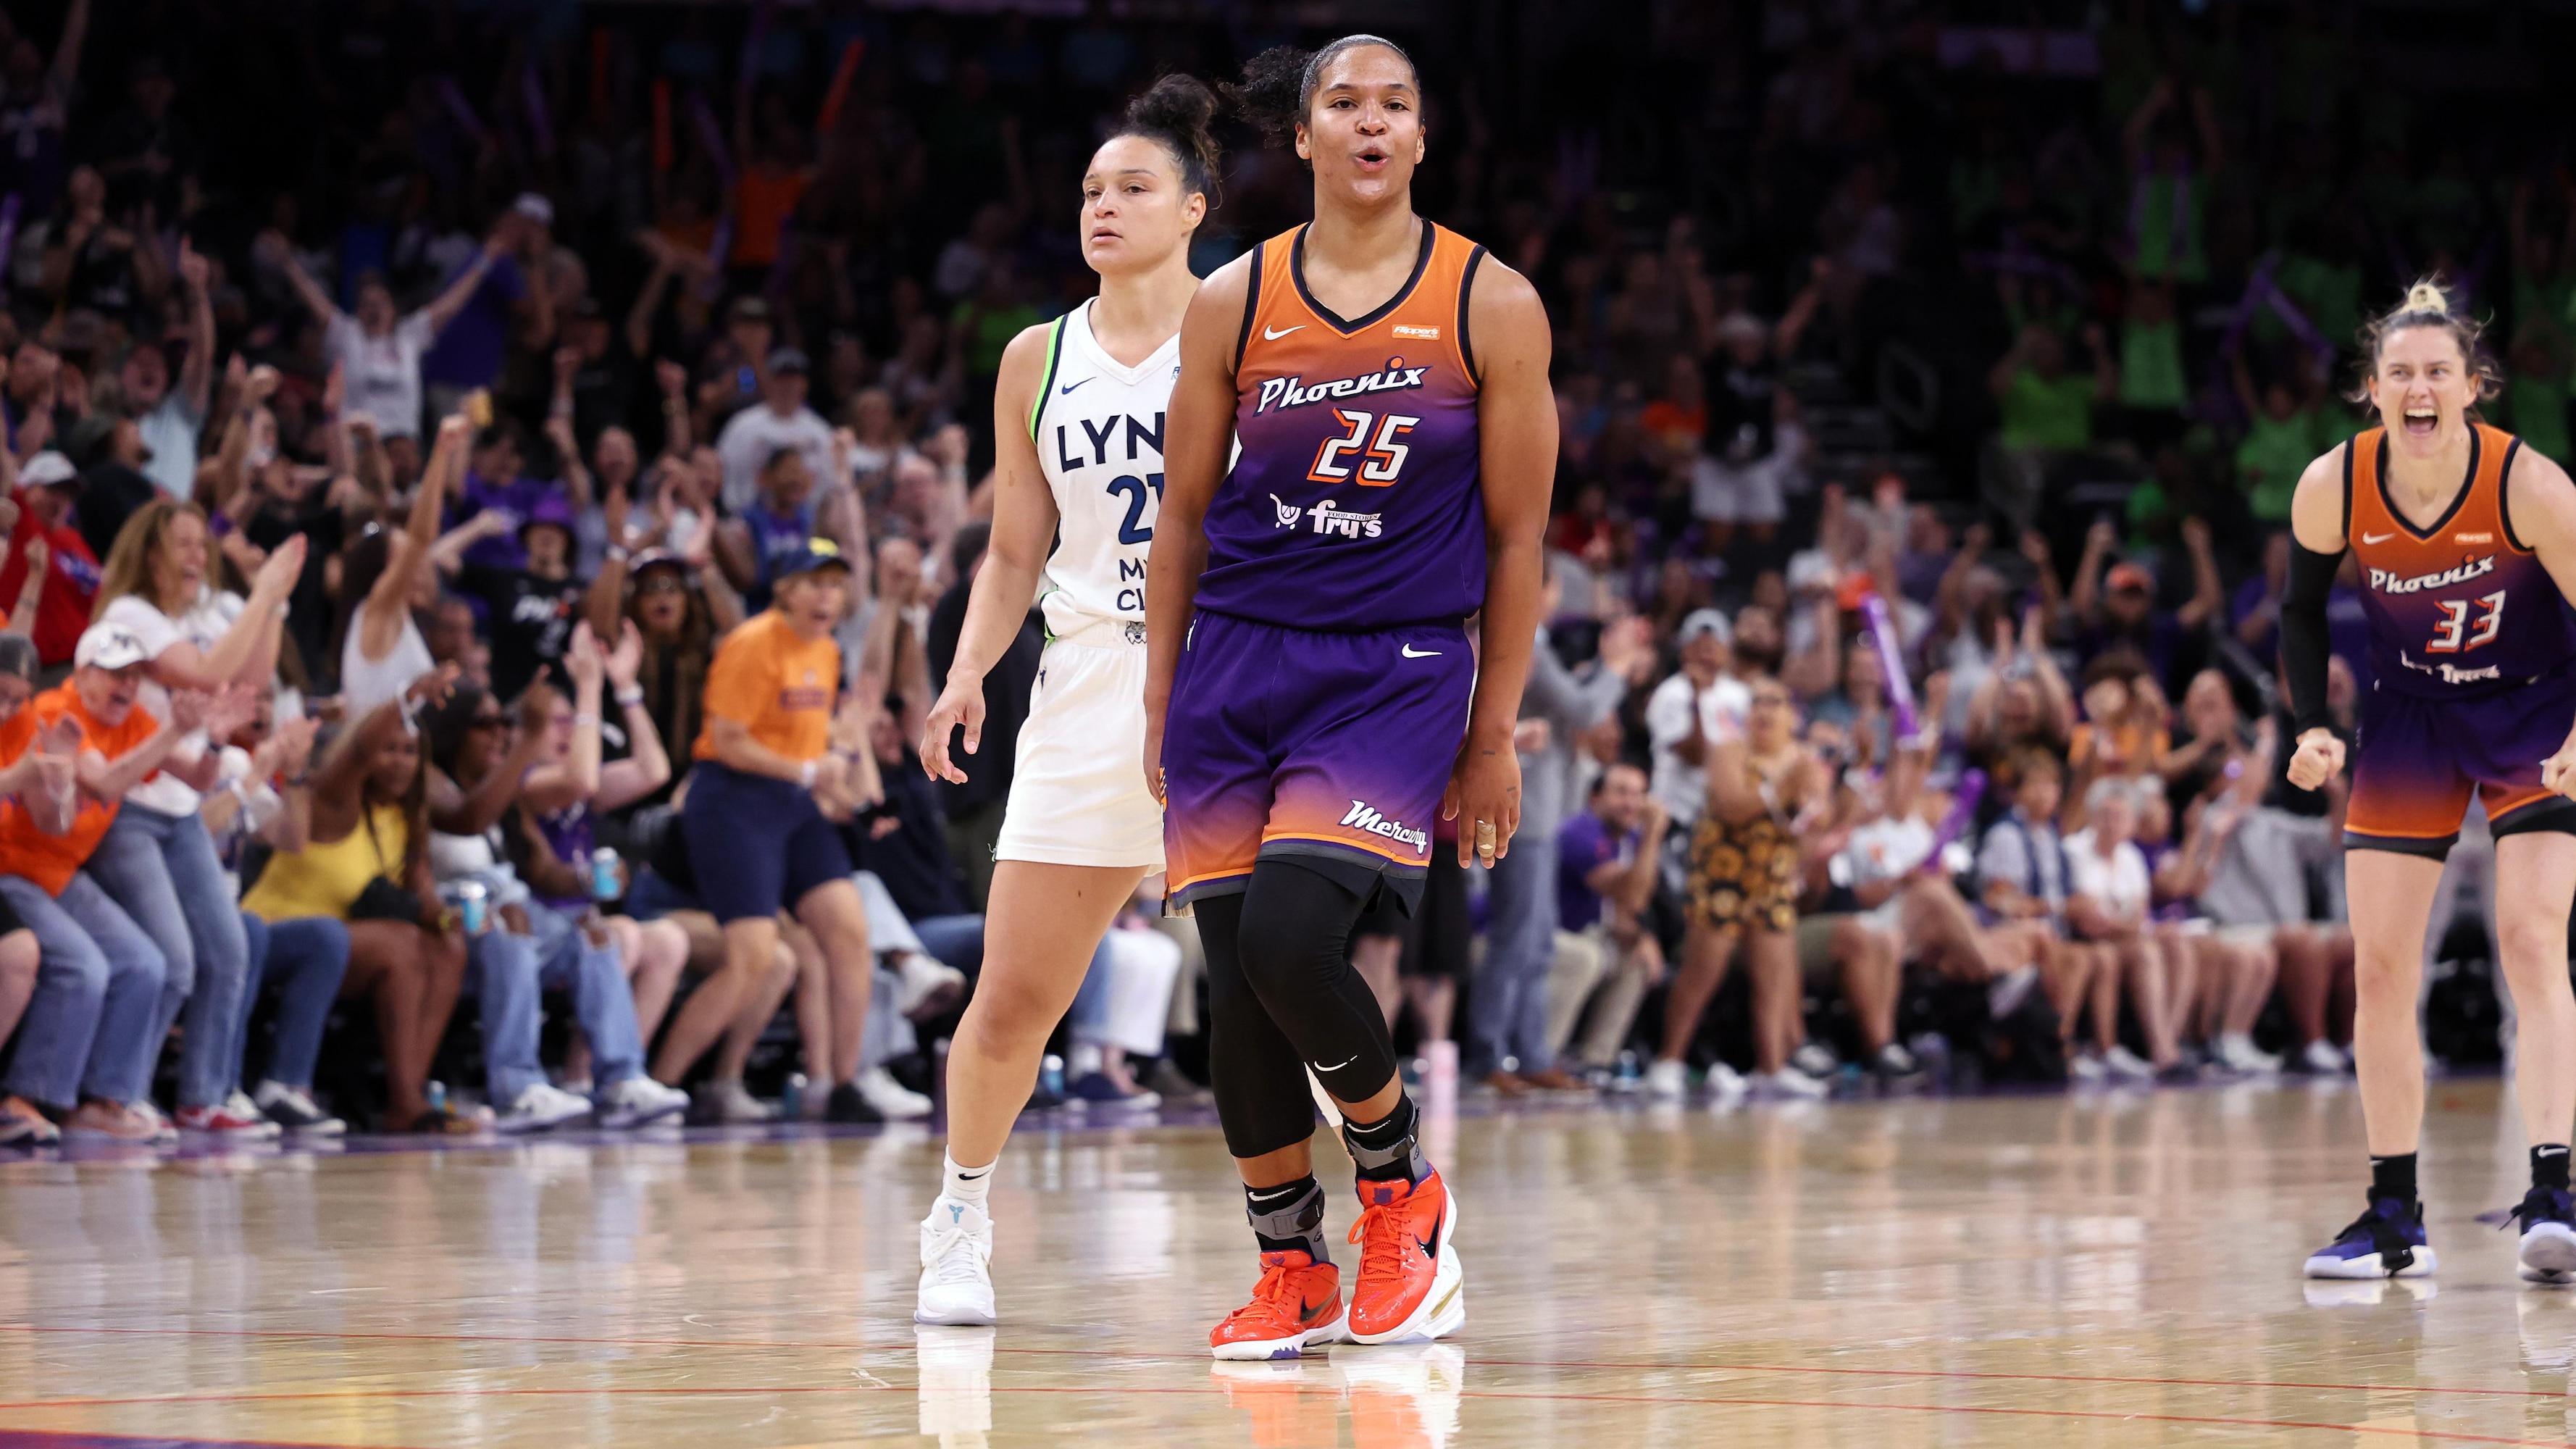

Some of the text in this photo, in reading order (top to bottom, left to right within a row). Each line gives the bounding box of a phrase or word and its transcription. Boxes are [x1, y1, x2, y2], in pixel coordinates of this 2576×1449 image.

[1255, 357, 1429, 414] Phoenix
[1057, 412, 1165, 473] LYN
[1306, 408, 1421, 486] 25
[1306, 500, 1382, 538] fry's
[1119, 557, 1147, 582] M
[2369, 554, 2496, 594] Phoenix
[2425, 590, 2506, 653] 33
